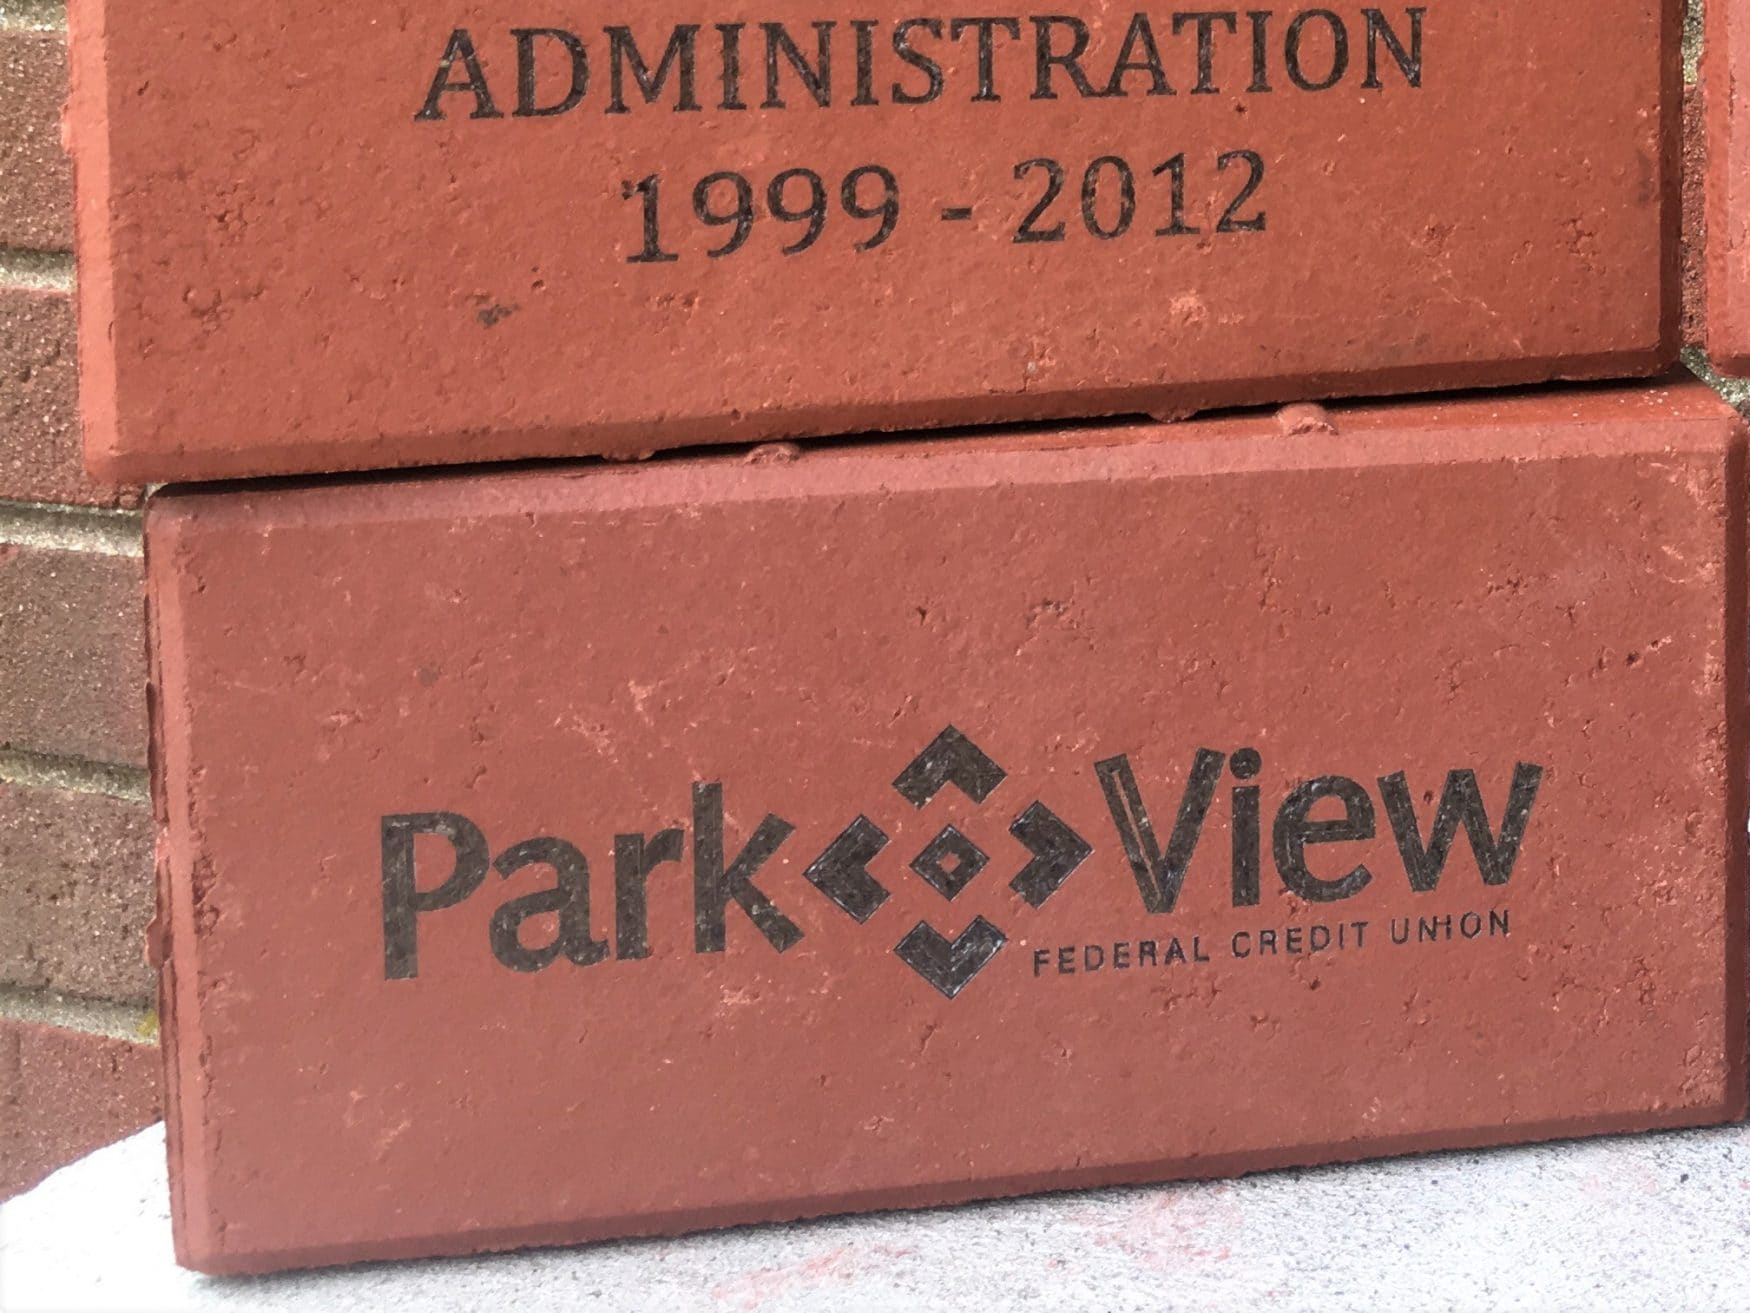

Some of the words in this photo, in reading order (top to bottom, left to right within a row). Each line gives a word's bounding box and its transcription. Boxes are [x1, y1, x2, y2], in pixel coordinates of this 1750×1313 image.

[414, 6, 1428, 121] ADMINISTRATION
[621, 164, 901, 265] 1999
[1012, 148, 1267, 245] 2012
[380, 782, 805, 981] Park
[1093, 746, 1544, 916] View
[1032, 935, 1211, 978] FEDERAL
[1230, 921, 1370, 960] CREDIT
[1390, 908, 1511, 946] UNION
